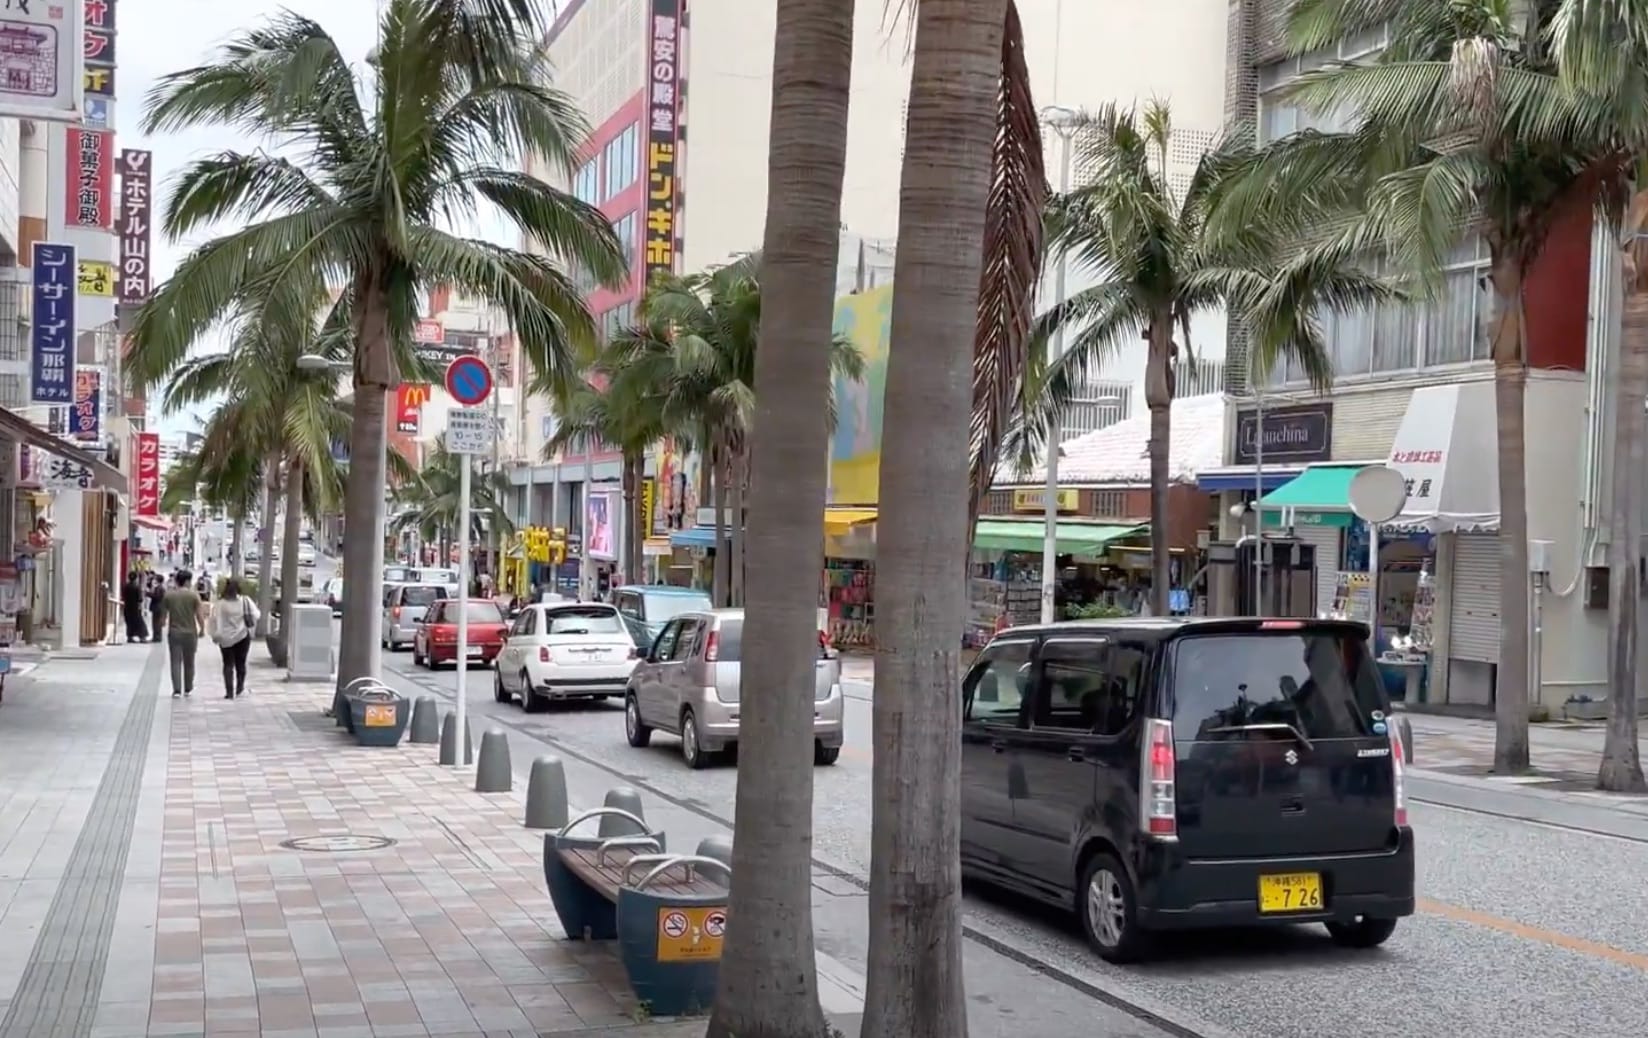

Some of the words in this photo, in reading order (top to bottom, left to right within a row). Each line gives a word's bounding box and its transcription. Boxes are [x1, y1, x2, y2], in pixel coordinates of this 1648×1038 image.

[651, 15, 676, 132] 驚安の殿堂
[78, 132, 99, 225] 御菓子御殿
[124, 180, 147, 296] ホテル山の内
[36, 387, 69, 398] ホテル
[139, 439, 157, 509] カラオケ
